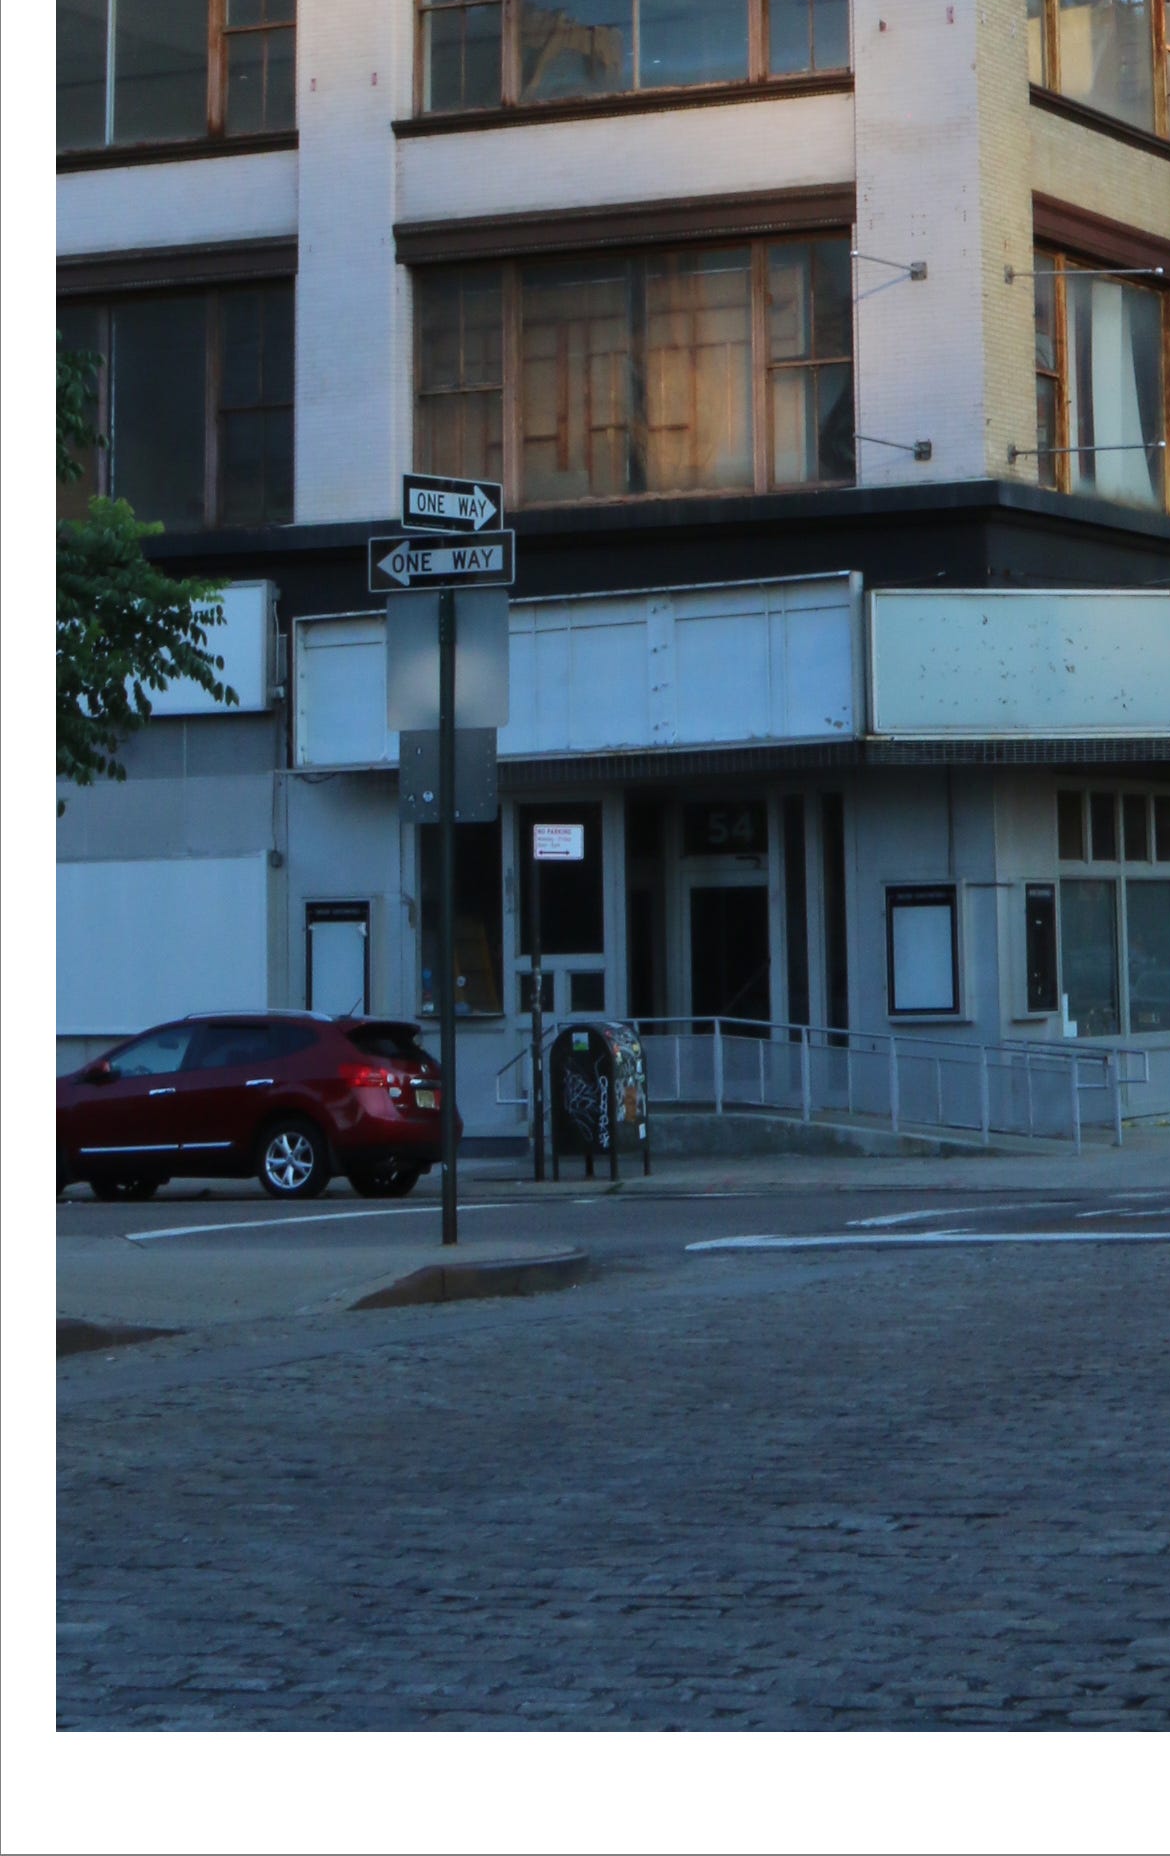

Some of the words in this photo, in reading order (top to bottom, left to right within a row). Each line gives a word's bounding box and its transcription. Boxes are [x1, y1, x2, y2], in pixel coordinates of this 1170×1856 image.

[417, 492, 445, 514] ONE
[458, 497, 487, 518] WAY
[392, 552, 432, 574] ONE
[452, 548, 494, 570] WAY
[709, 812, 754, 844] 54
